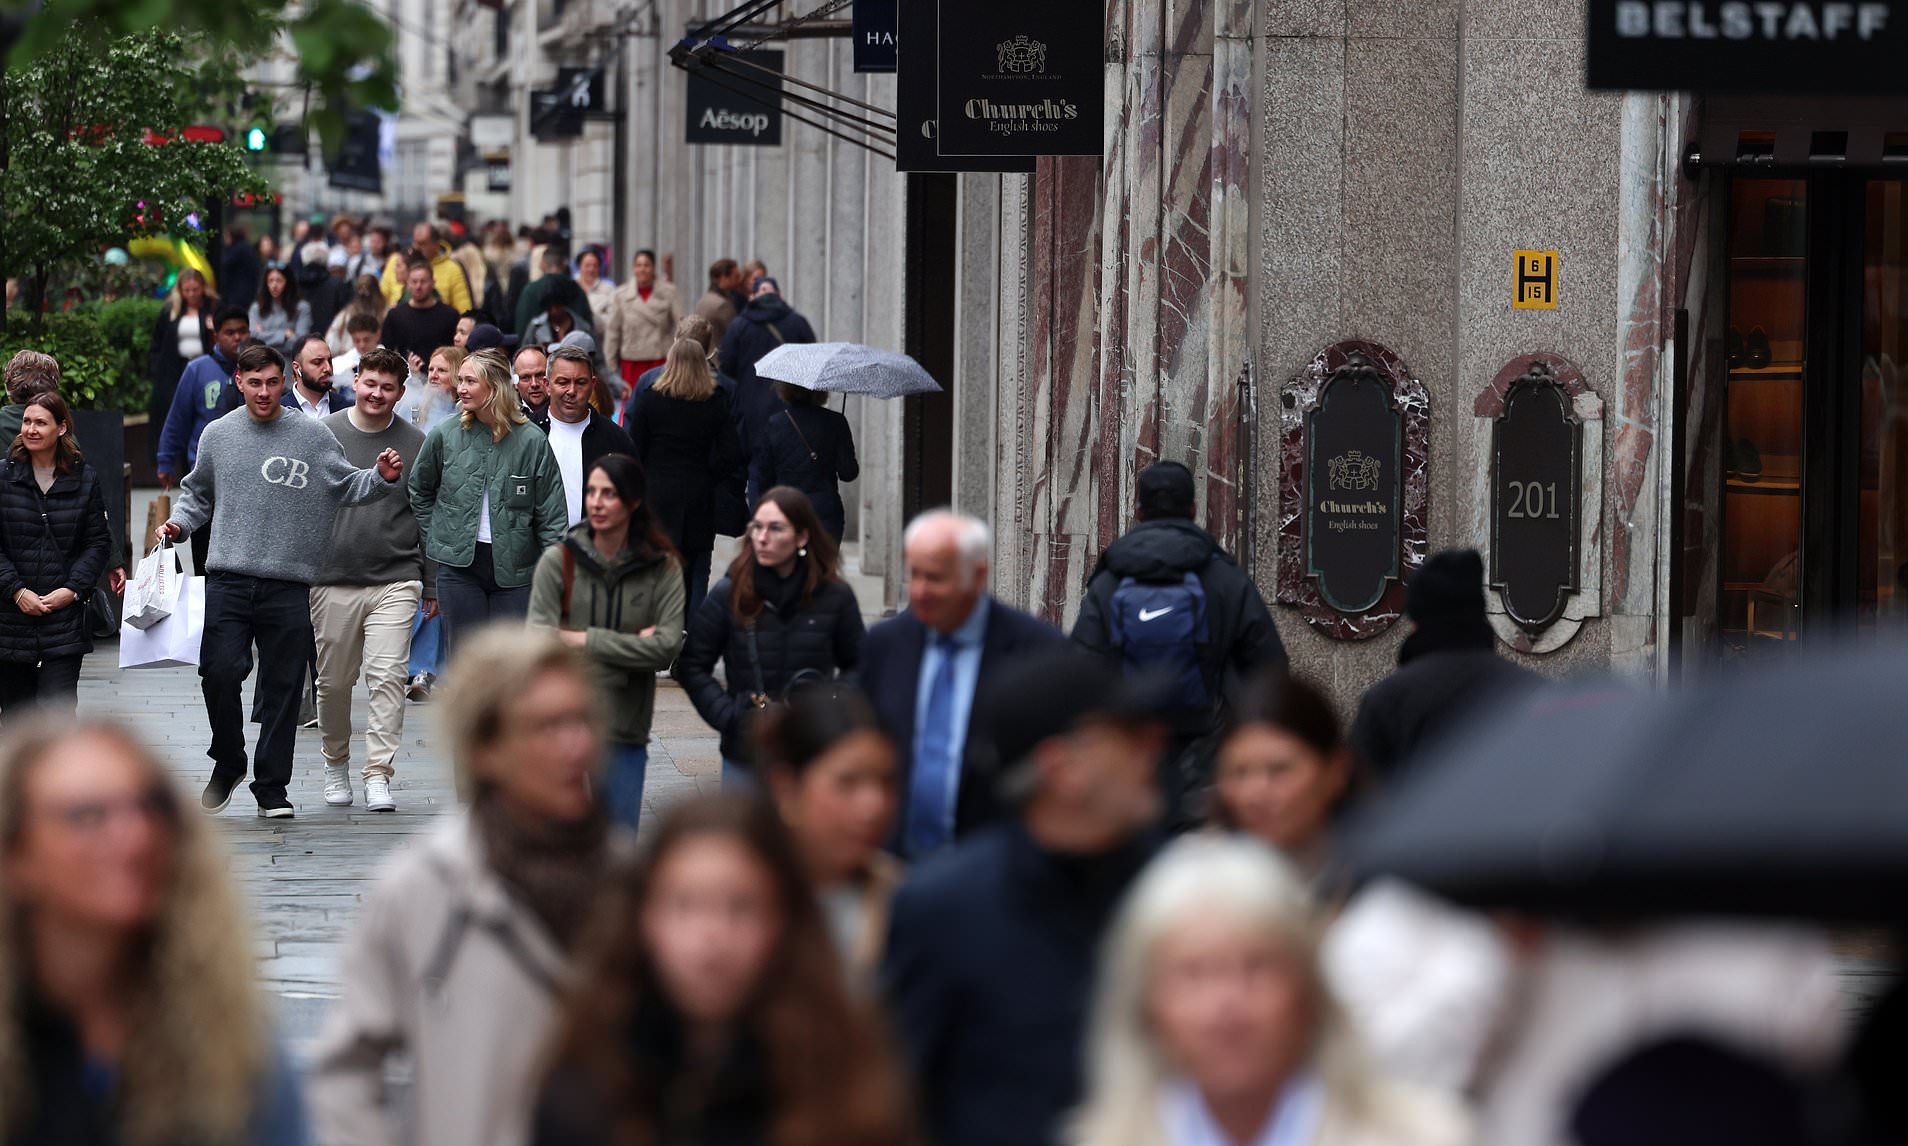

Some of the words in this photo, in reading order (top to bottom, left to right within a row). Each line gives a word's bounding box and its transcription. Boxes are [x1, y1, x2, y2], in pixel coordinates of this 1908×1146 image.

[1614, 2, 1890, 40] BELSTAFF
[867, 31, 897, 45] HA
[965, 99, 1078, 119] Church's
[990, 120, 1028, 136] English
[1031, 120, 1058, 131] shoes
[1532, 260, 1538, 272] 6
[1519, 256, 1551, 302] H
[1528, 286, 1541, 298] 15
[261, 456, 309, 489] CB
[1320, 501, 1387, 513] Church's
[1508, 481, 1560, 519] 201
[1329, 520, 1357, 533] English
[1359, 520, 1378, 529] shoes
